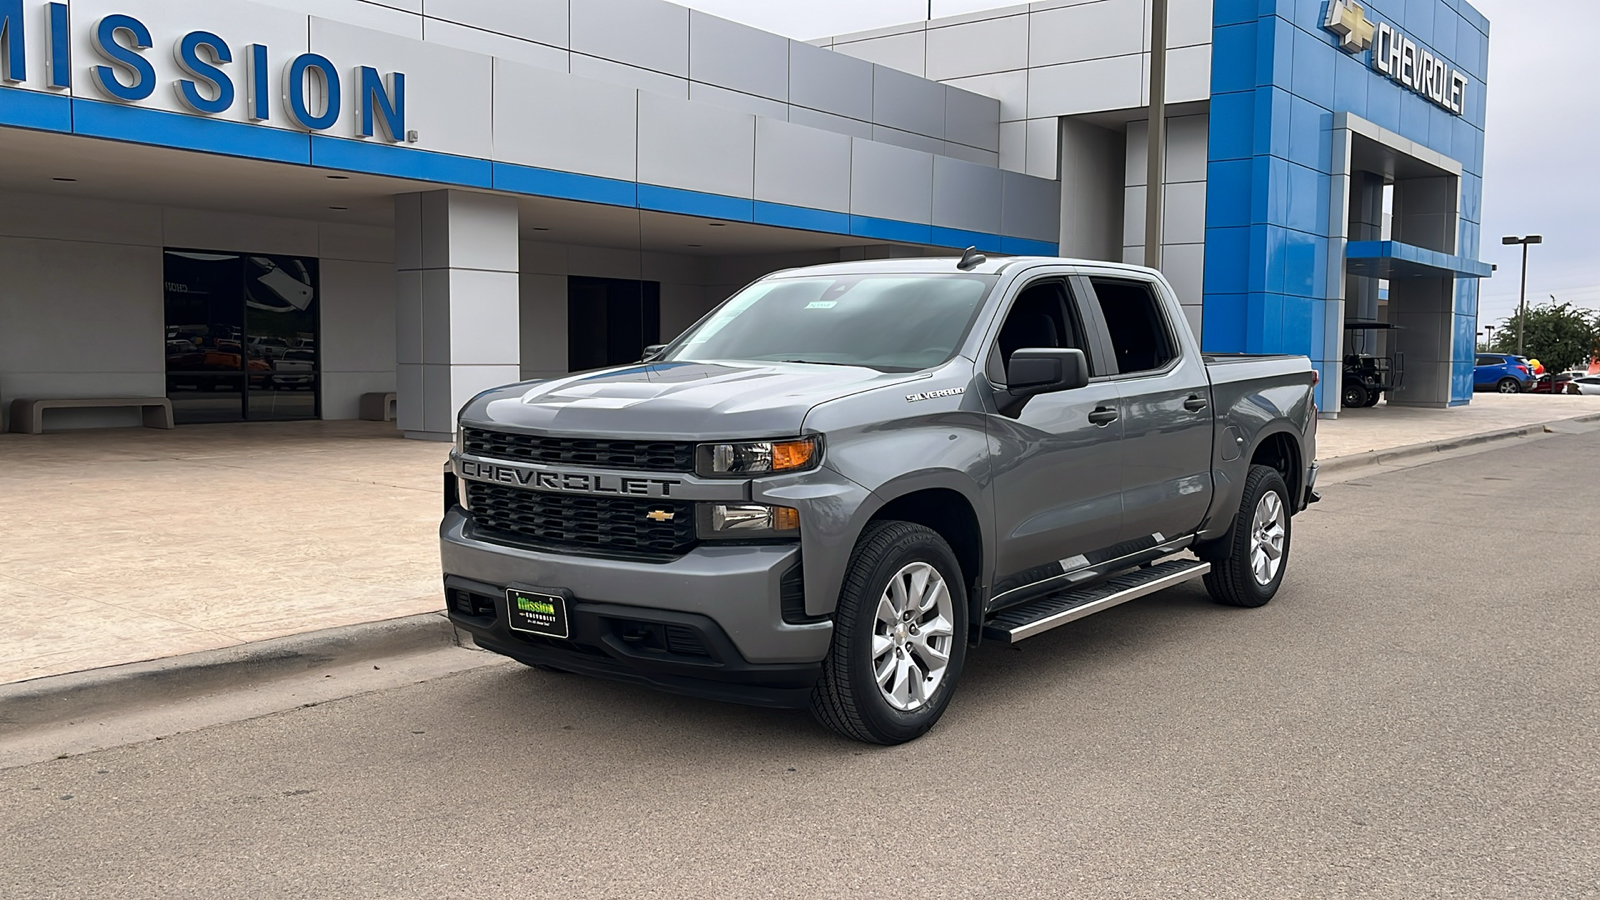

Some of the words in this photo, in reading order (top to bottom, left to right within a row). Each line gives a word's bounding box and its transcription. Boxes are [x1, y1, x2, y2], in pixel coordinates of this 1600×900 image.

[1374, 21, 1468, 116] CHEVROLET
[905, 387, 965, 403] SILVERADO
[461, 461, 681, 496] CHEVROLET
